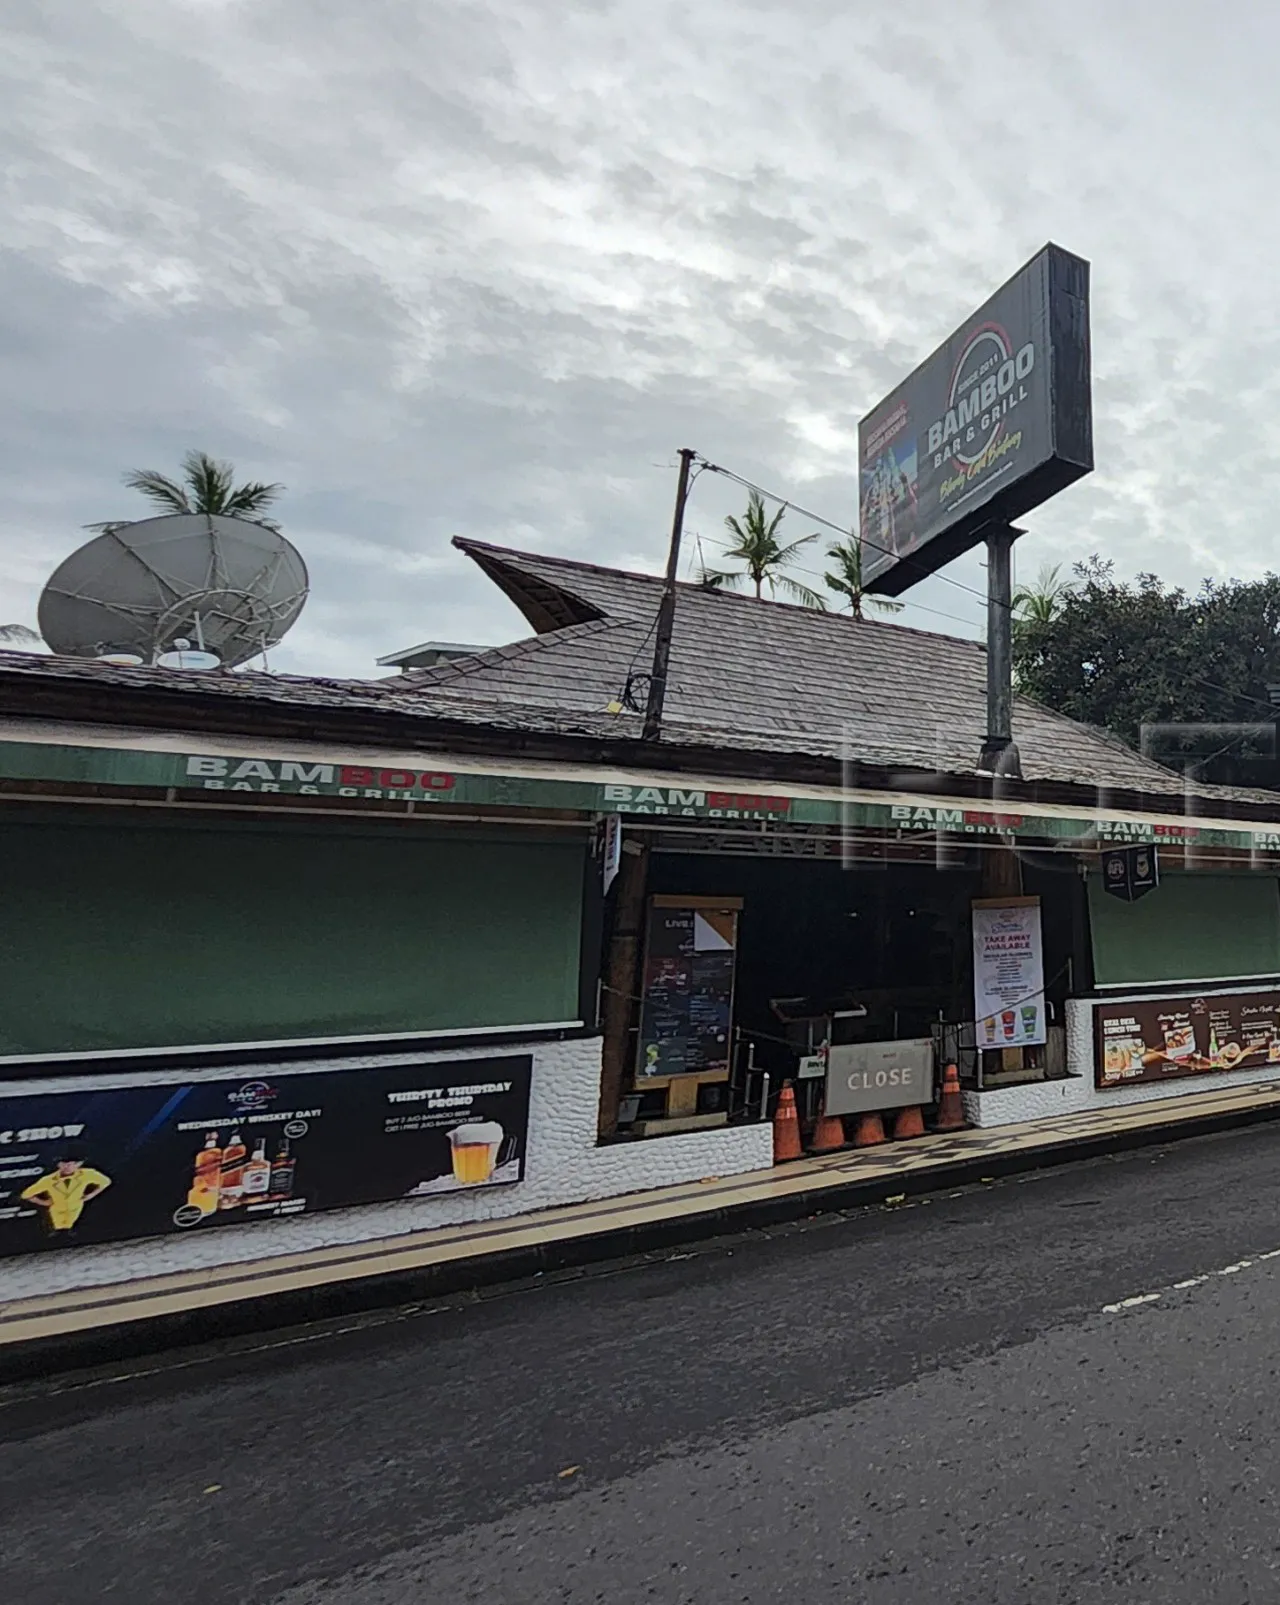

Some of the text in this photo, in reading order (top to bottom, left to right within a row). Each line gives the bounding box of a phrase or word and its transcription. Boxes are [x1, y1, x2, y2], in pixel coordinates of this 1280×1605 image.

[979, 353, 999, 376] 2011
[928, 343, 1035, 455] BAMBOO
[934, 386, 1028, 469] BAR & GRILL
[186, 756, 456, 792] BAMBOO
[203, 779, 442, 801] BAR & GRILL
[604, 785, 790, 812] BAMBOO
[617, 803, 779, 821] BAR & GRILL
[890, 805, 1023, 827] BAMBOO
[900, 820, 1016, 836] BAR & GRILL
[1097, 821, 1199, 837] BAMBOO
[1103, 833, 1133, 842] BAR
[1152, 836, 1193, 846] GRILL
[984, 933, 1031, 944] TAKE AWAY
[984, 942, 1030, 952] AVAILABLE
[848, 1068, 912, 1090] CLOSE
[388, 1081, 512, 1103] THIRSTY THURSDAY
[427, 1095, 473, 1109] PROMO
[178, 1117, 246, 1131] WEDNESDAY
[248, 1111, 295, 1124] WHISKEY
[16, 1124, 86, 1143] SHOW
